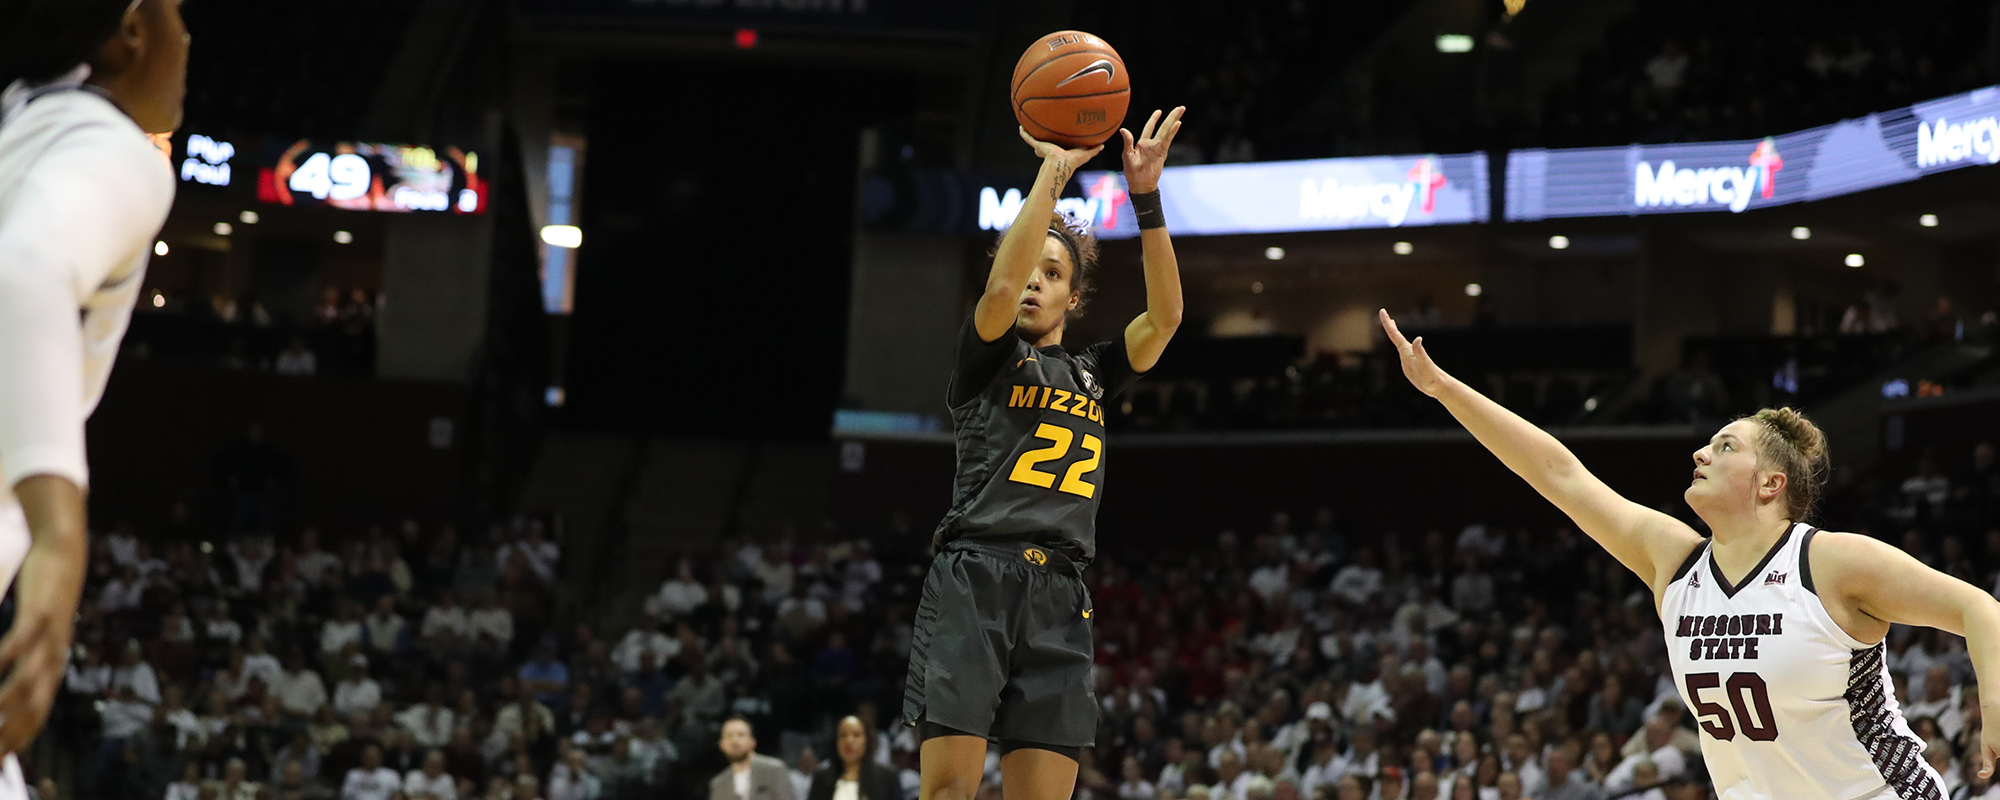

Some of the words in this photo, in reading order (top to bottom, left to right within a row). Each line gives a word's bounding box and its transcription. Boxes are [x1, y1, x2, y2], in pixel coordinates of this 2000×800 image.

[1917, 116, 2000, 166] Mercy
[289, 151, 371, 200] 49
[1634, 159, 1758, 213] Mercy
[978, 186, 1100, 237] Mcy
[1300, 176, 1415, 227] Mercy
[1008, 422, 1102, 499] 22
[1675, 613, 1783, 637] MISSOURI
[1689, 637, 1759, 661] STATE
[1685, 671, 1779, 742] 50
[1884, 763, 1896, 779] ADY
[1891, 739, 1907, 763] BEARS
